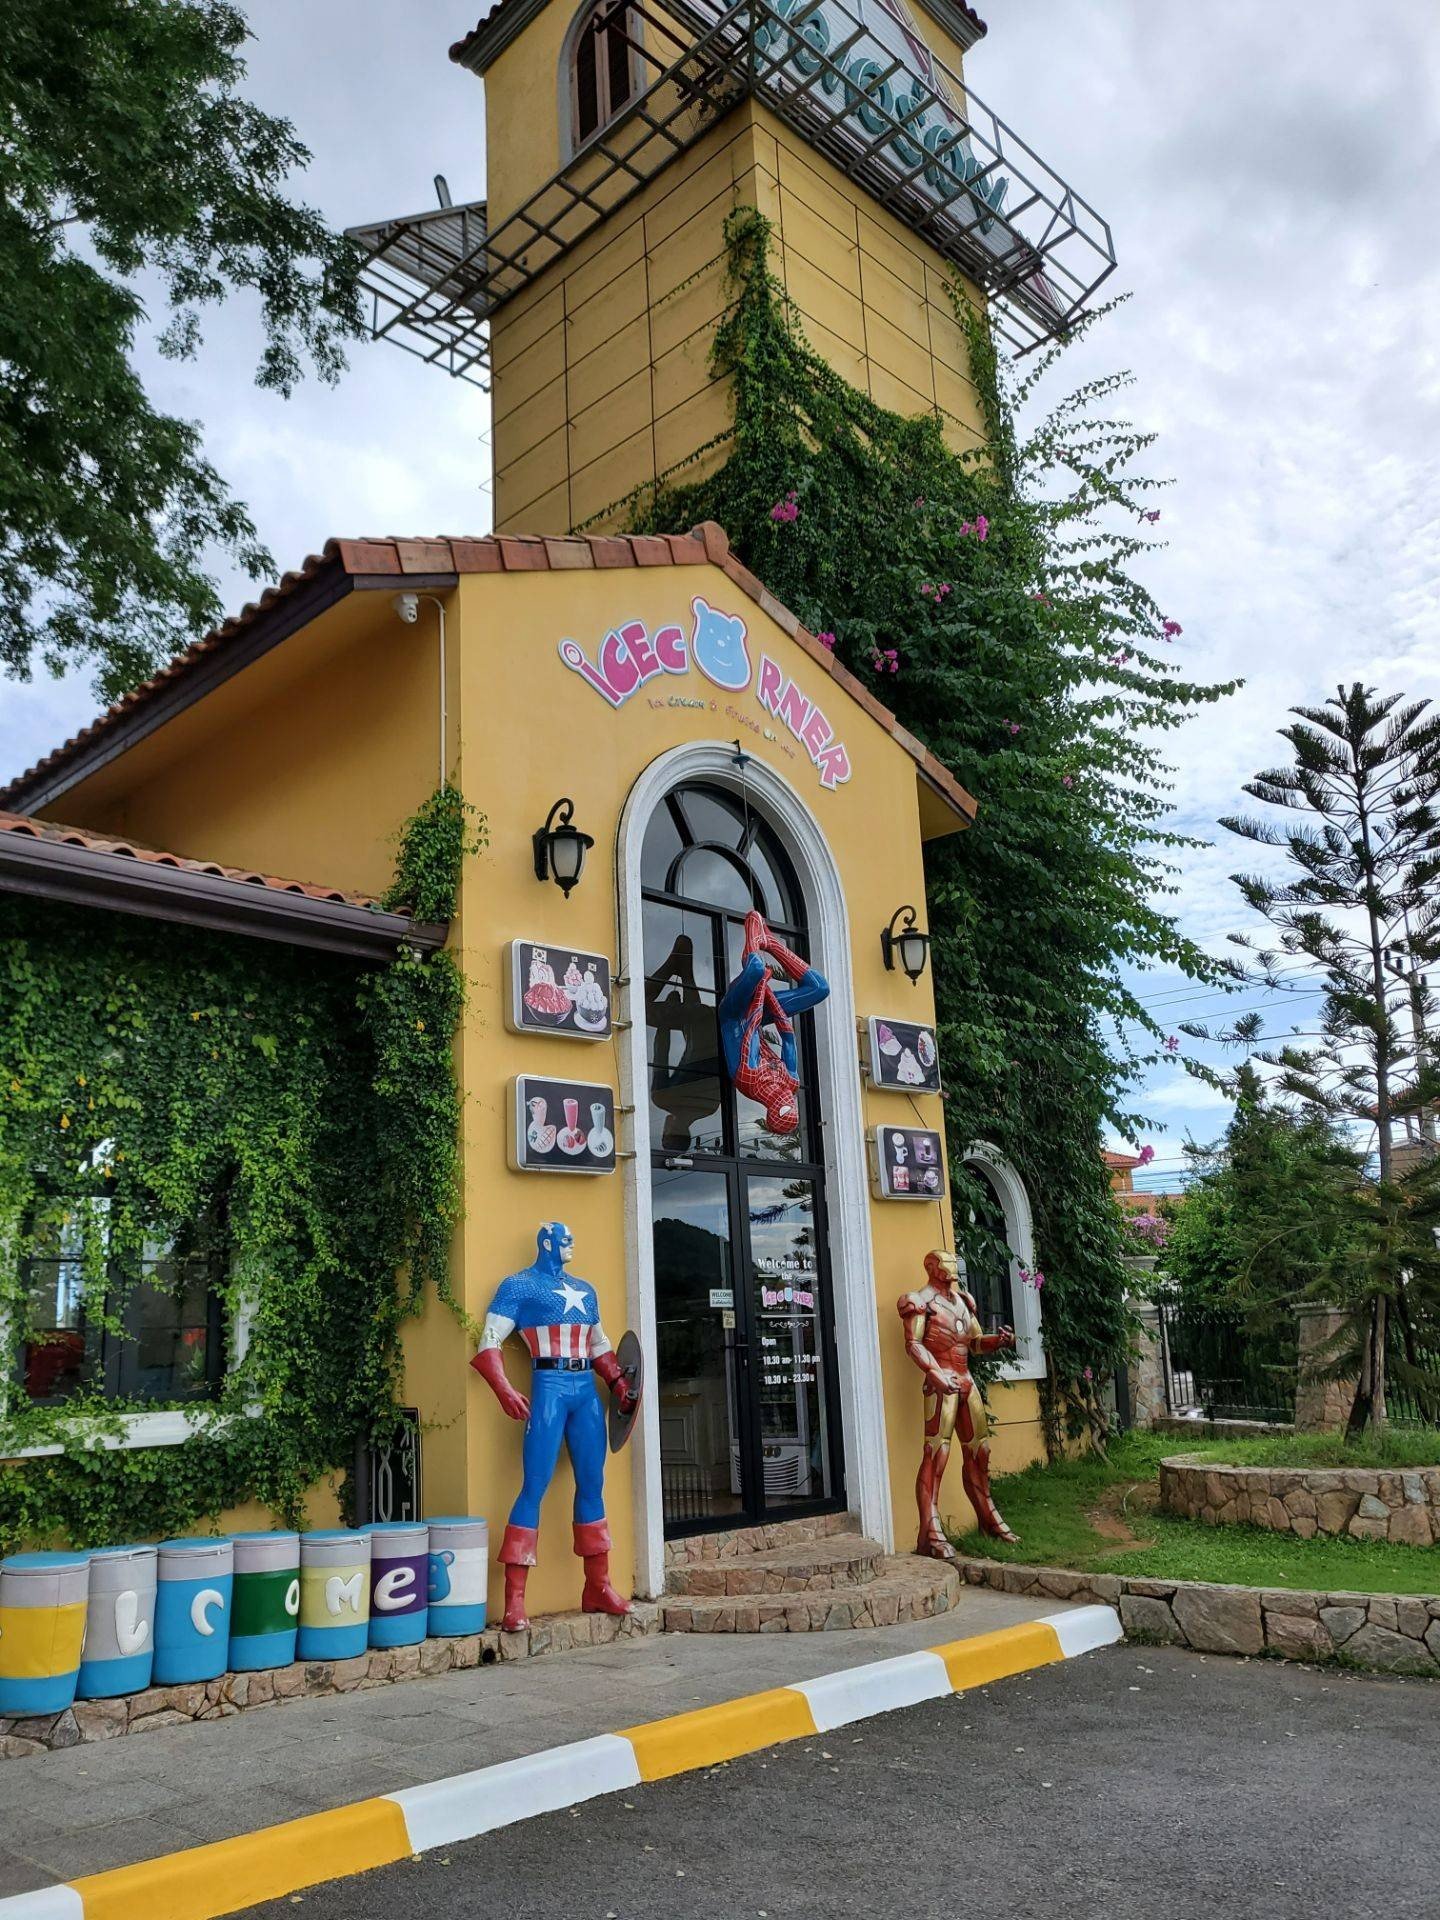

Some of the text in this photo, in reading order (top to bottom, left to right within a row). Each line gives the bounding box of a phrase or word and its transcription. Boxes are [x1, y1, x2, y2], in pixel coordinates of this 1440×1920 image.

[758, 1258, 813, 1270] Welcome to
[761, 1336, 777, 1348] Open
[763, 1355, 780, 1366] 10.30
[793, 1353, 811, 1364] 11.30
[764, 1374, 782, 1385] 10.30
[792, 1373, 810, 1383] 23.30
